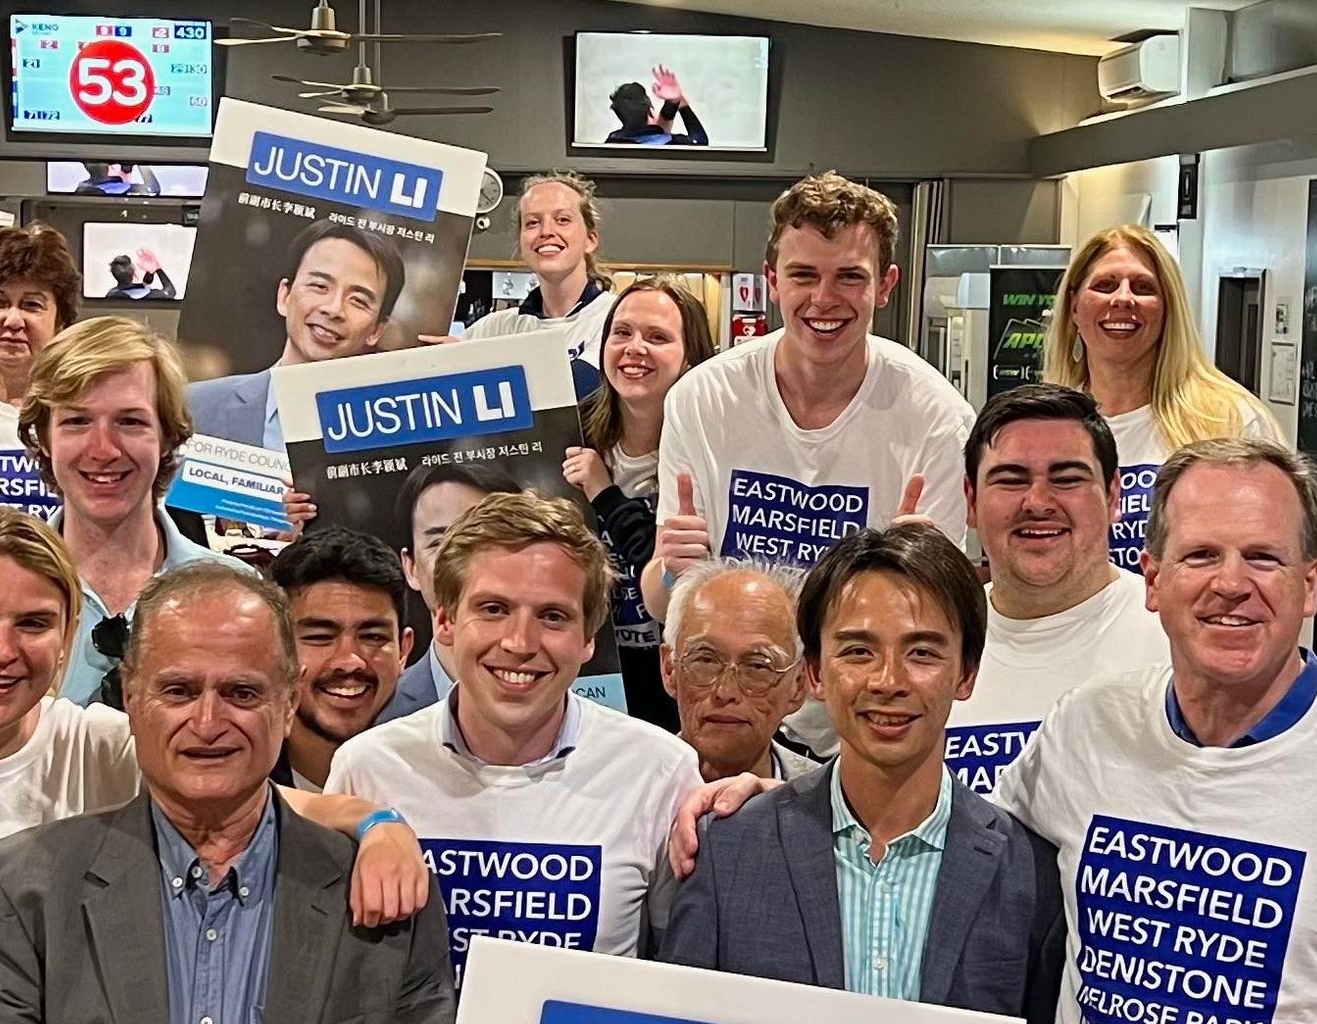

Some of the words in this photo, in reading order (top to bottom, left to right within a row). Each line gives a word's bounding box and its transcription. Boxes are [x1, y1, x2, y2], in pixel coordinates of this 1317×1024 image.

[175, 25, 205, 39] 430
[78, 57, 148, 106] 53
[254, 146, 382, 199] JUSTIN
[390, 172, 428, 208] LI
[327, 388, 464, 441] JUSTIN
[473, 381, 516, 421] LI
[215, 445, 246, 461] RYDE
[249, 453, 291, 472] COUNC
[189, 467, 228, 485] LOCAL,
[232, 477, 284, 495] FAMILIAR
[733, 478, 863, 513] EASTWOOD
[732, 504, 860, 539] MARSFIELD
[736, 532, 794, 557] WEST
[797, 542, 830, 562] RY
[576, 685, 607, 700] CAN
[423, 849, 594, 882] ASTWOOD
[1088, 827, 1292, 888] EASTWOOD
[444, 888, 592, 921] RSFIELD
[1080, 866, 1283, 930] MARSFIELD
[1087, 908, 1170, 947] WEST
[1173, 928, 1268, 969] RYDE
[1081, 945, 1267, 1009] DENISTONE
